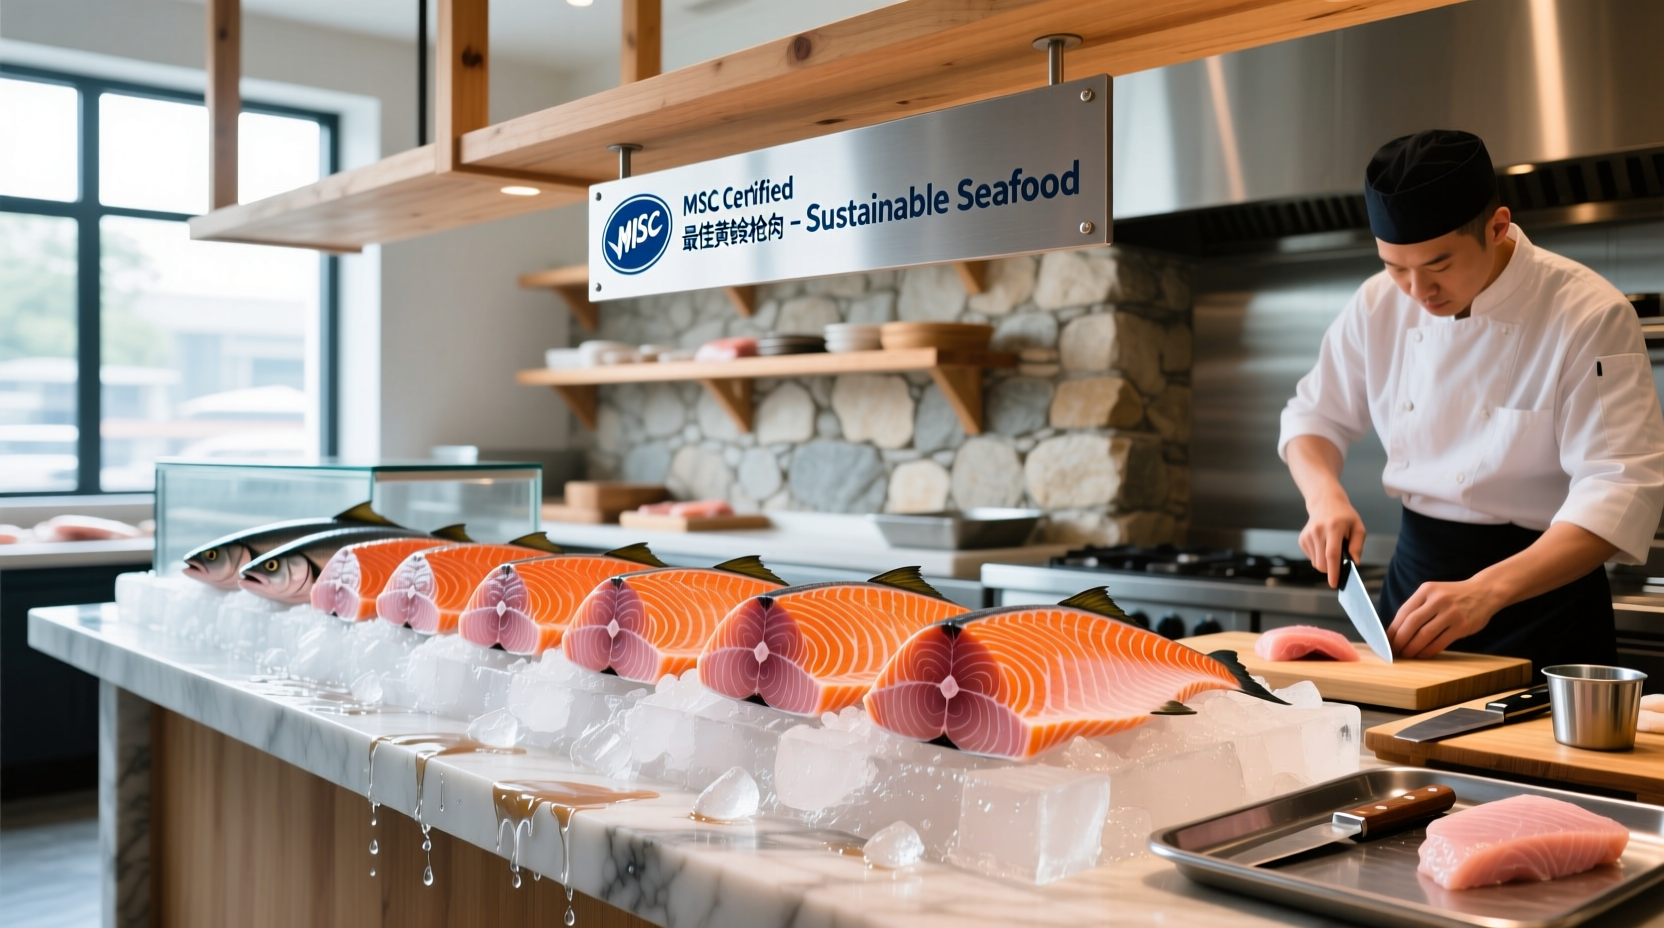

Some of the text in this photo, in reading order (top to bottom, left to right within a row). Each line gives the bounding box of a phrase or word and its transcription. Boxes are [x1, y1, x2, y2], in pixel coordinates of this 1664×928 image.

[682, 189, 720, 217] MSC
[806, 182, 951, 233] Sustainable
[956, 159, 1080, 212] Seafood
